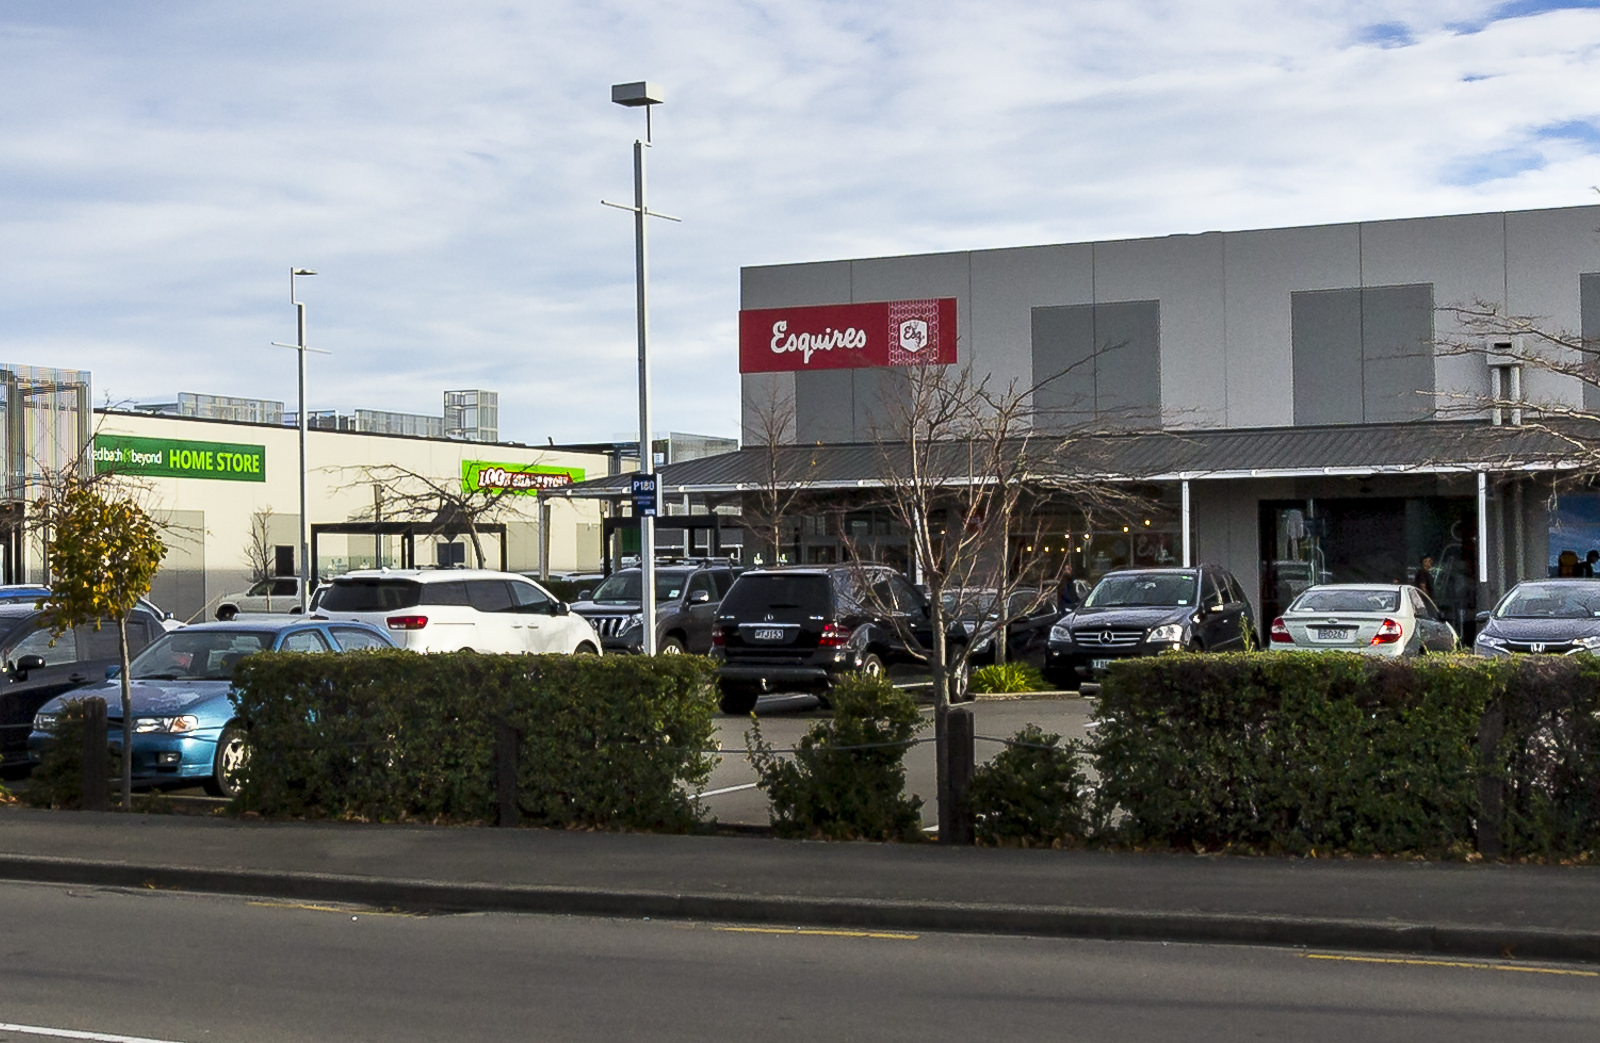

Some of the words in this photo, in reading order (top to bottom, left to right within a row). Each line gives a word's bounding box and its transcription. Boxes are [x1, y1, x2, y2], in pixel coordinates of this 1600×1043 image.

[770, 320, 867, 365] Esquires
[131, 449, 162, 466] beyond
[169, 449, 213, 471] HOME
[216, 452, 260, 473] STORE
